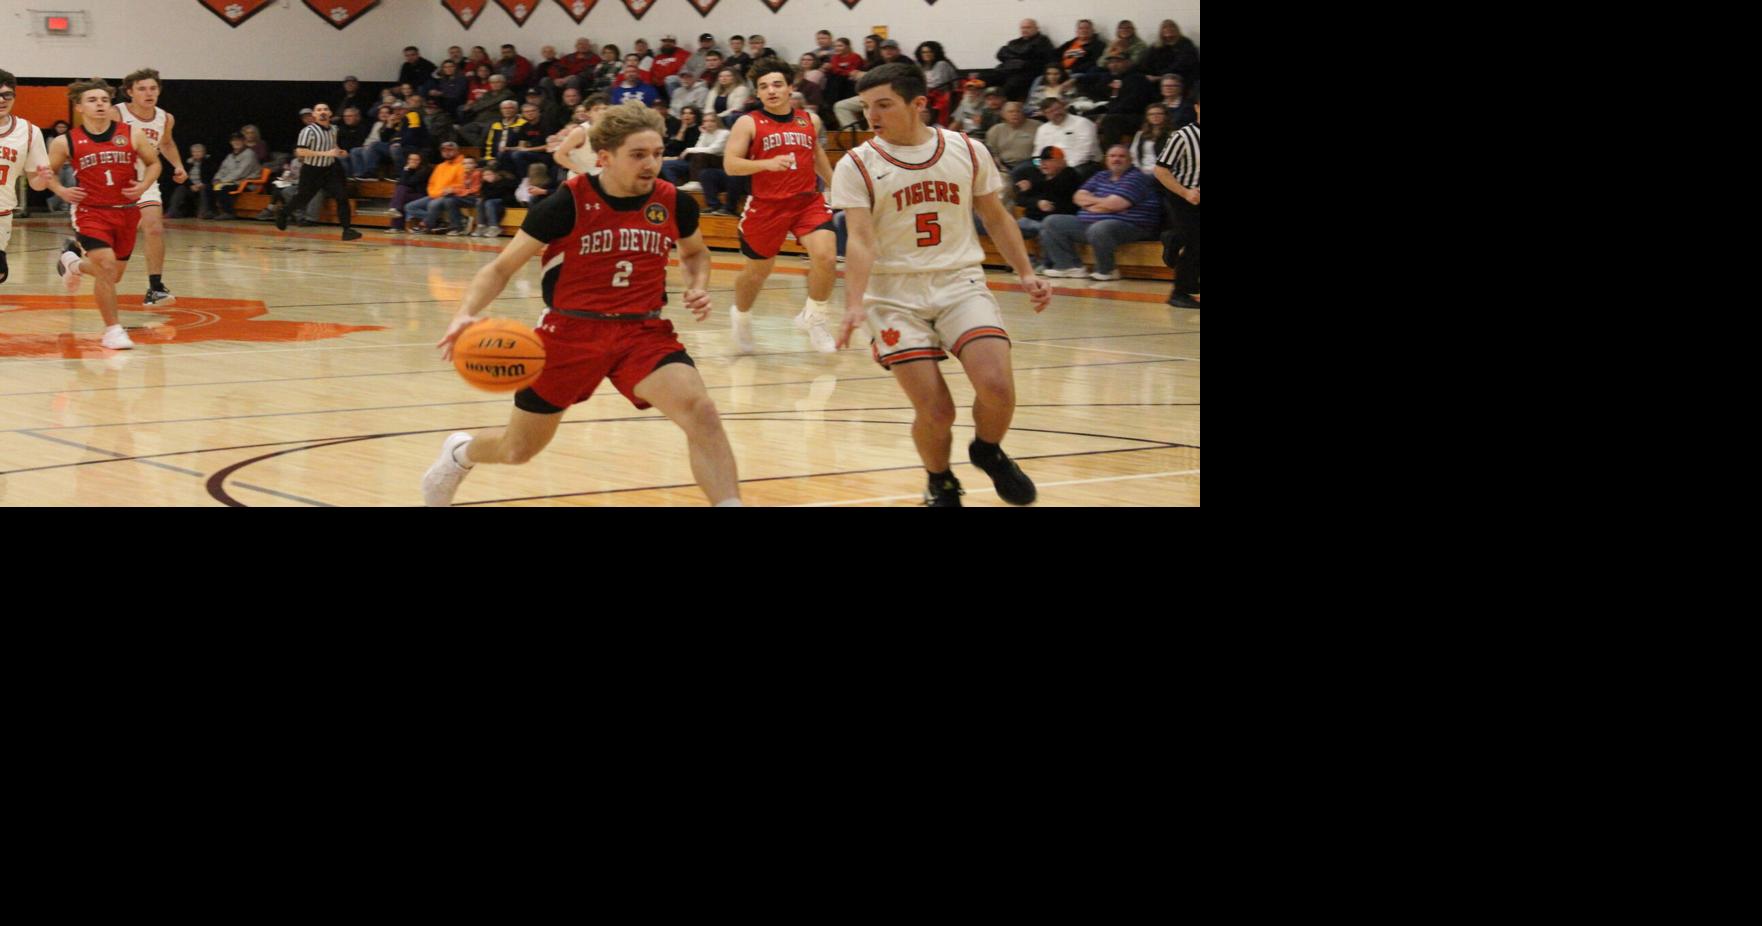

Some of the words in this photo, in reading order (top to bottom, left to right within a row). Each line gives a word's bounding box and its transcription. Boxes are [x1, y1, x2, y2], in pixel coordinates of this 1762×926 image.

[763, 132, 782, 151] RED
[783, 131, 813, 149] DEVILS
[104, 169, 115, 186] 1
[892, 180, 960, 212] TIGERS
[647, 209, 665, 221] 44
[915, 212, 942, 248] 5
[579, 229, 613, 255] RED
[611, 260, 633, 287] 2
[465, 361, 526, 377] Wilson
